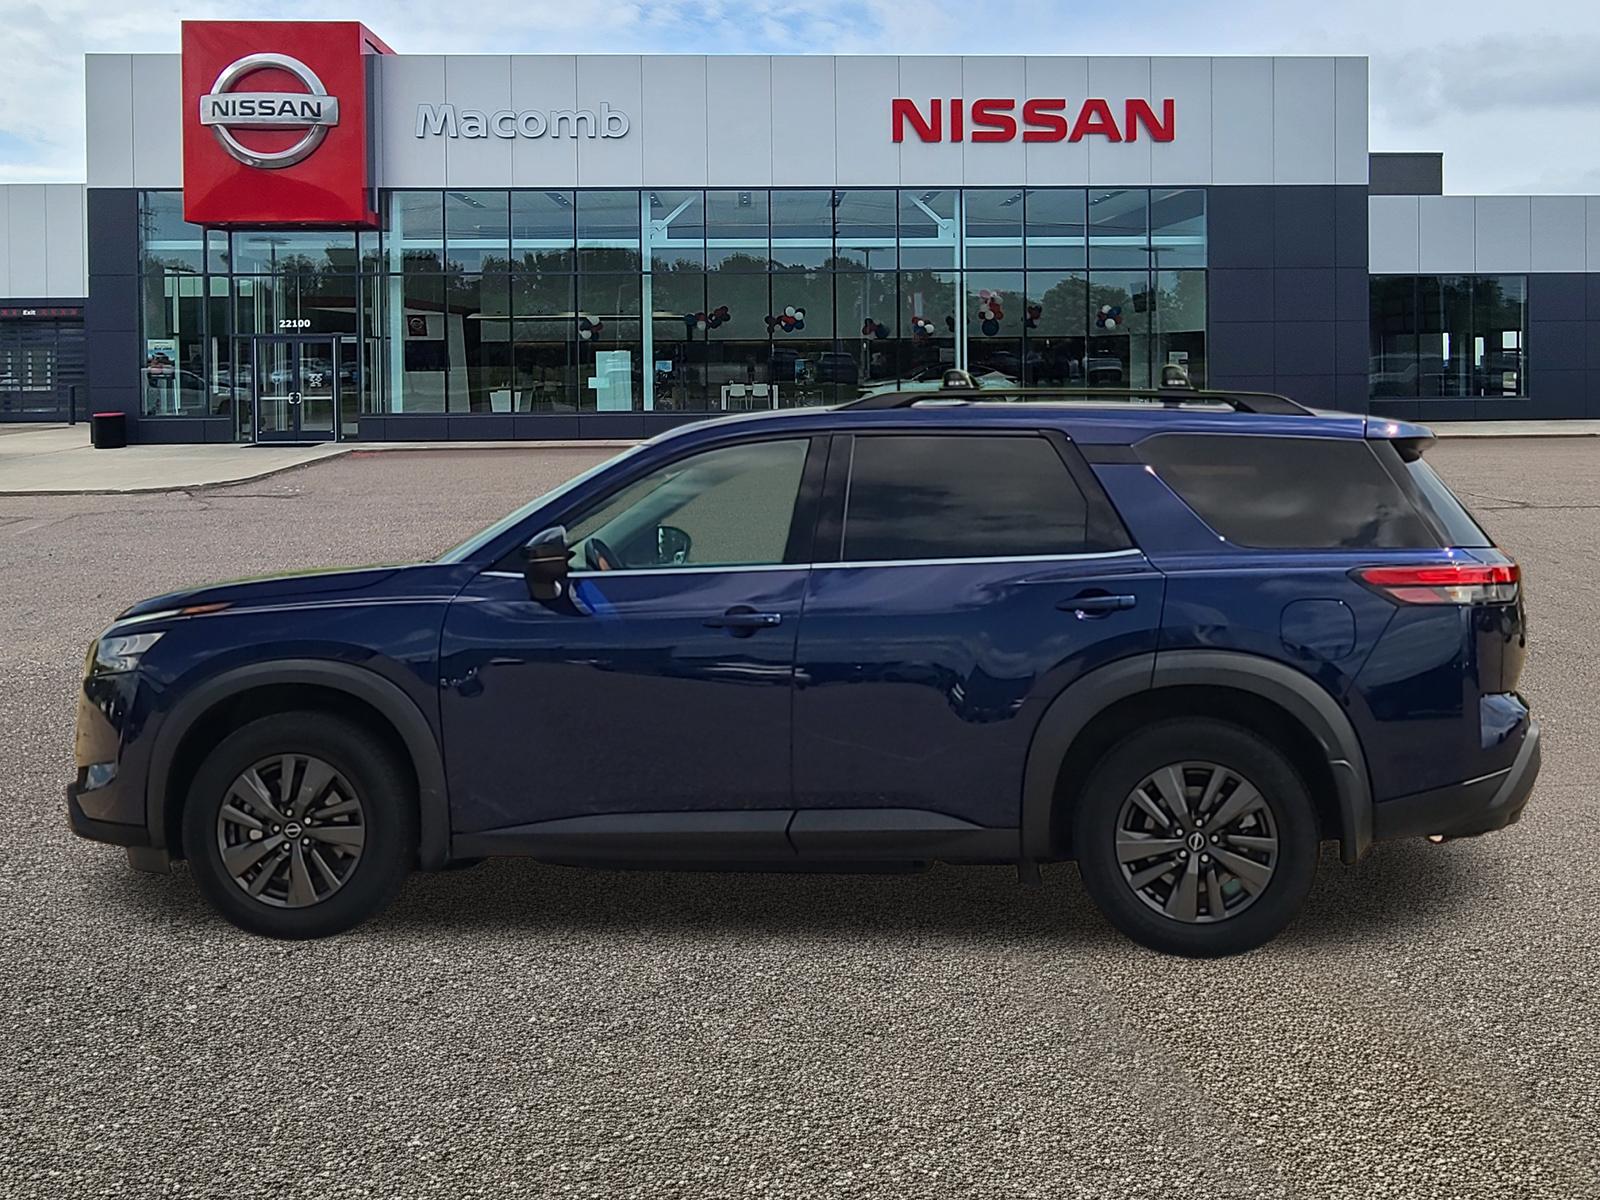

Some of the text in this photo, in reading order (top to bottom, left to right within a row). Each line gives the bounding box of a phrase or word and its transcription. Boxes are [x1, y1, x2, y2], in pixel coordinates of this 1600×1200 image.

[211, 100, 322, 118] NISSAN
[415, 102, 630, 138] Macomb
[892, 98, 1175, 142] NISSAN
[279, 319, 311, 328] 22100
